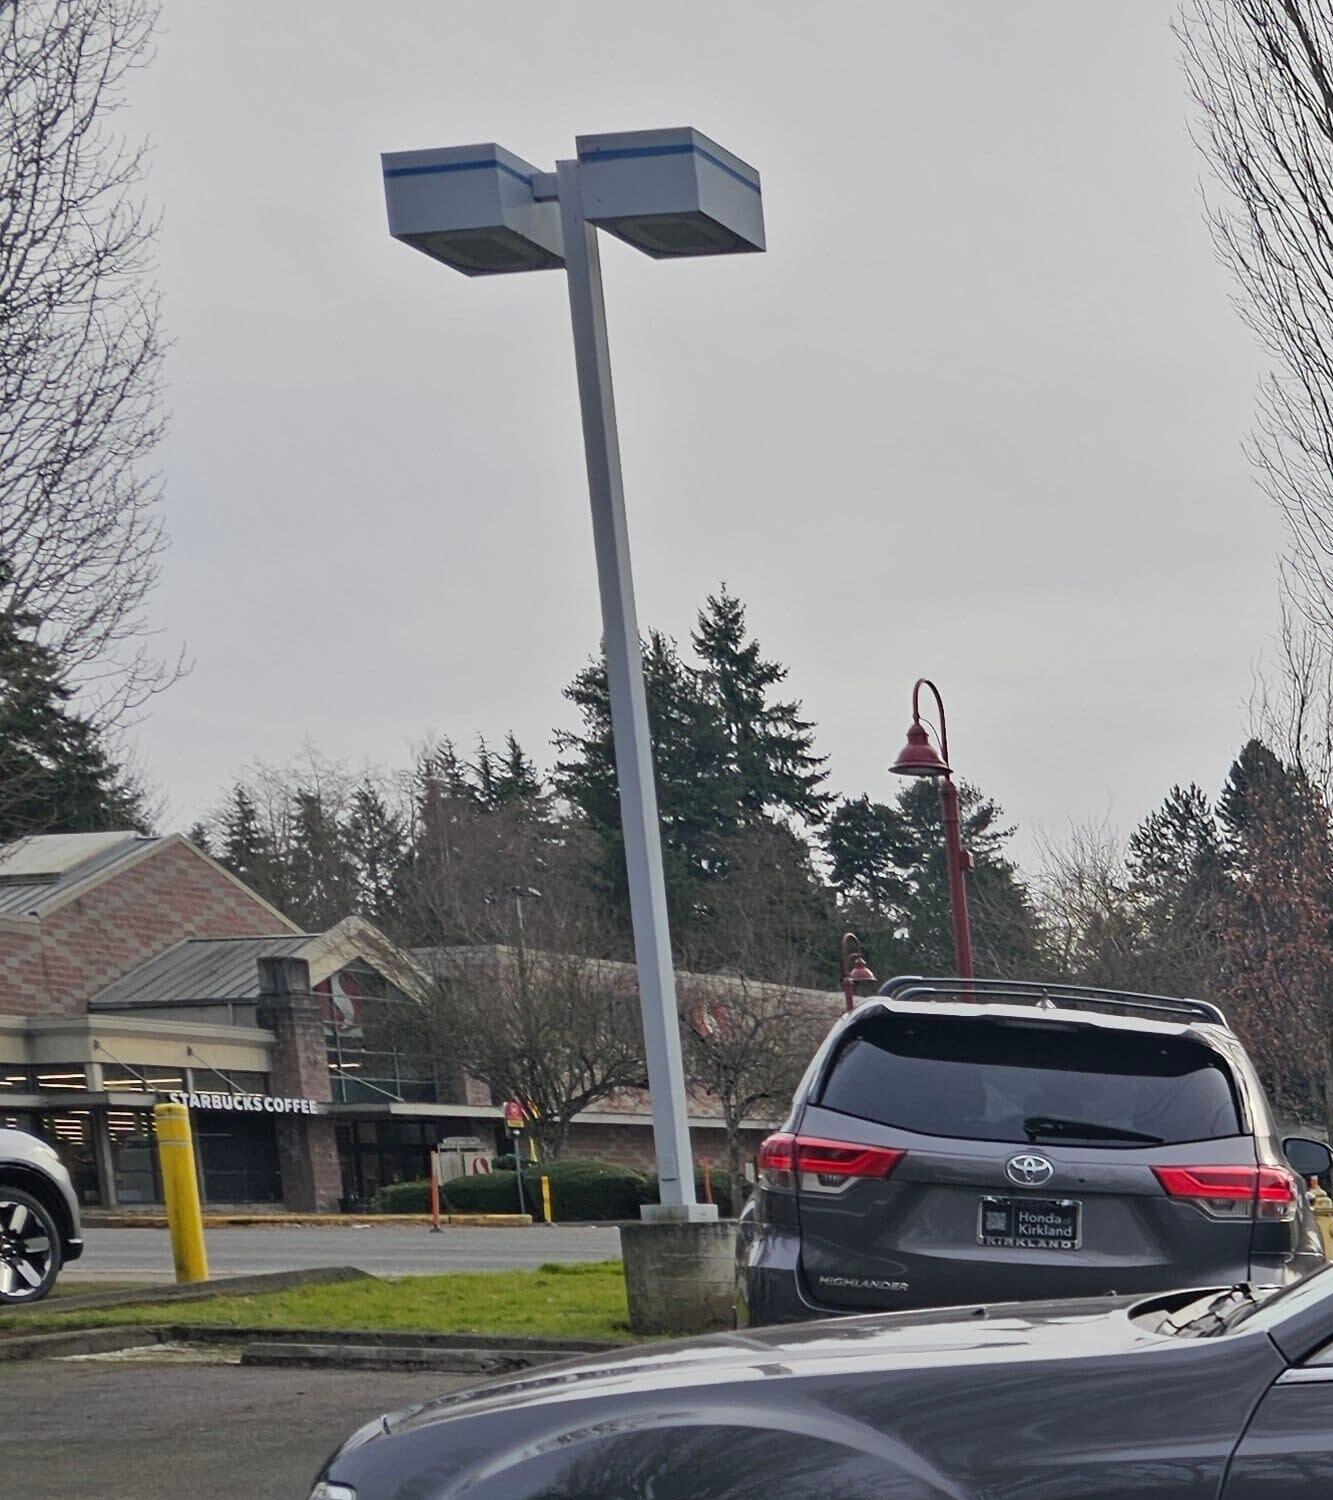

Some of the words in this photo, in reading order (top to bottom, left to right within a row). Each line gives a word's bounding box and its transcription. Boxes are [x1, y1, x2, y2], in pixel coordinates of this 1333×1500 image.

[169, 1092, 264, 1113] STARBUCKS
[264, 1097, 318, 1114] COFFEE
[1019, 1211, 1061, 1224] Honda
[1019, 1223, 1072, 1237] Kirkland
[986, 1237, 1072, 1249] KIRKLAND
[819, 1276, 909, 1292] HIGHLANDER
